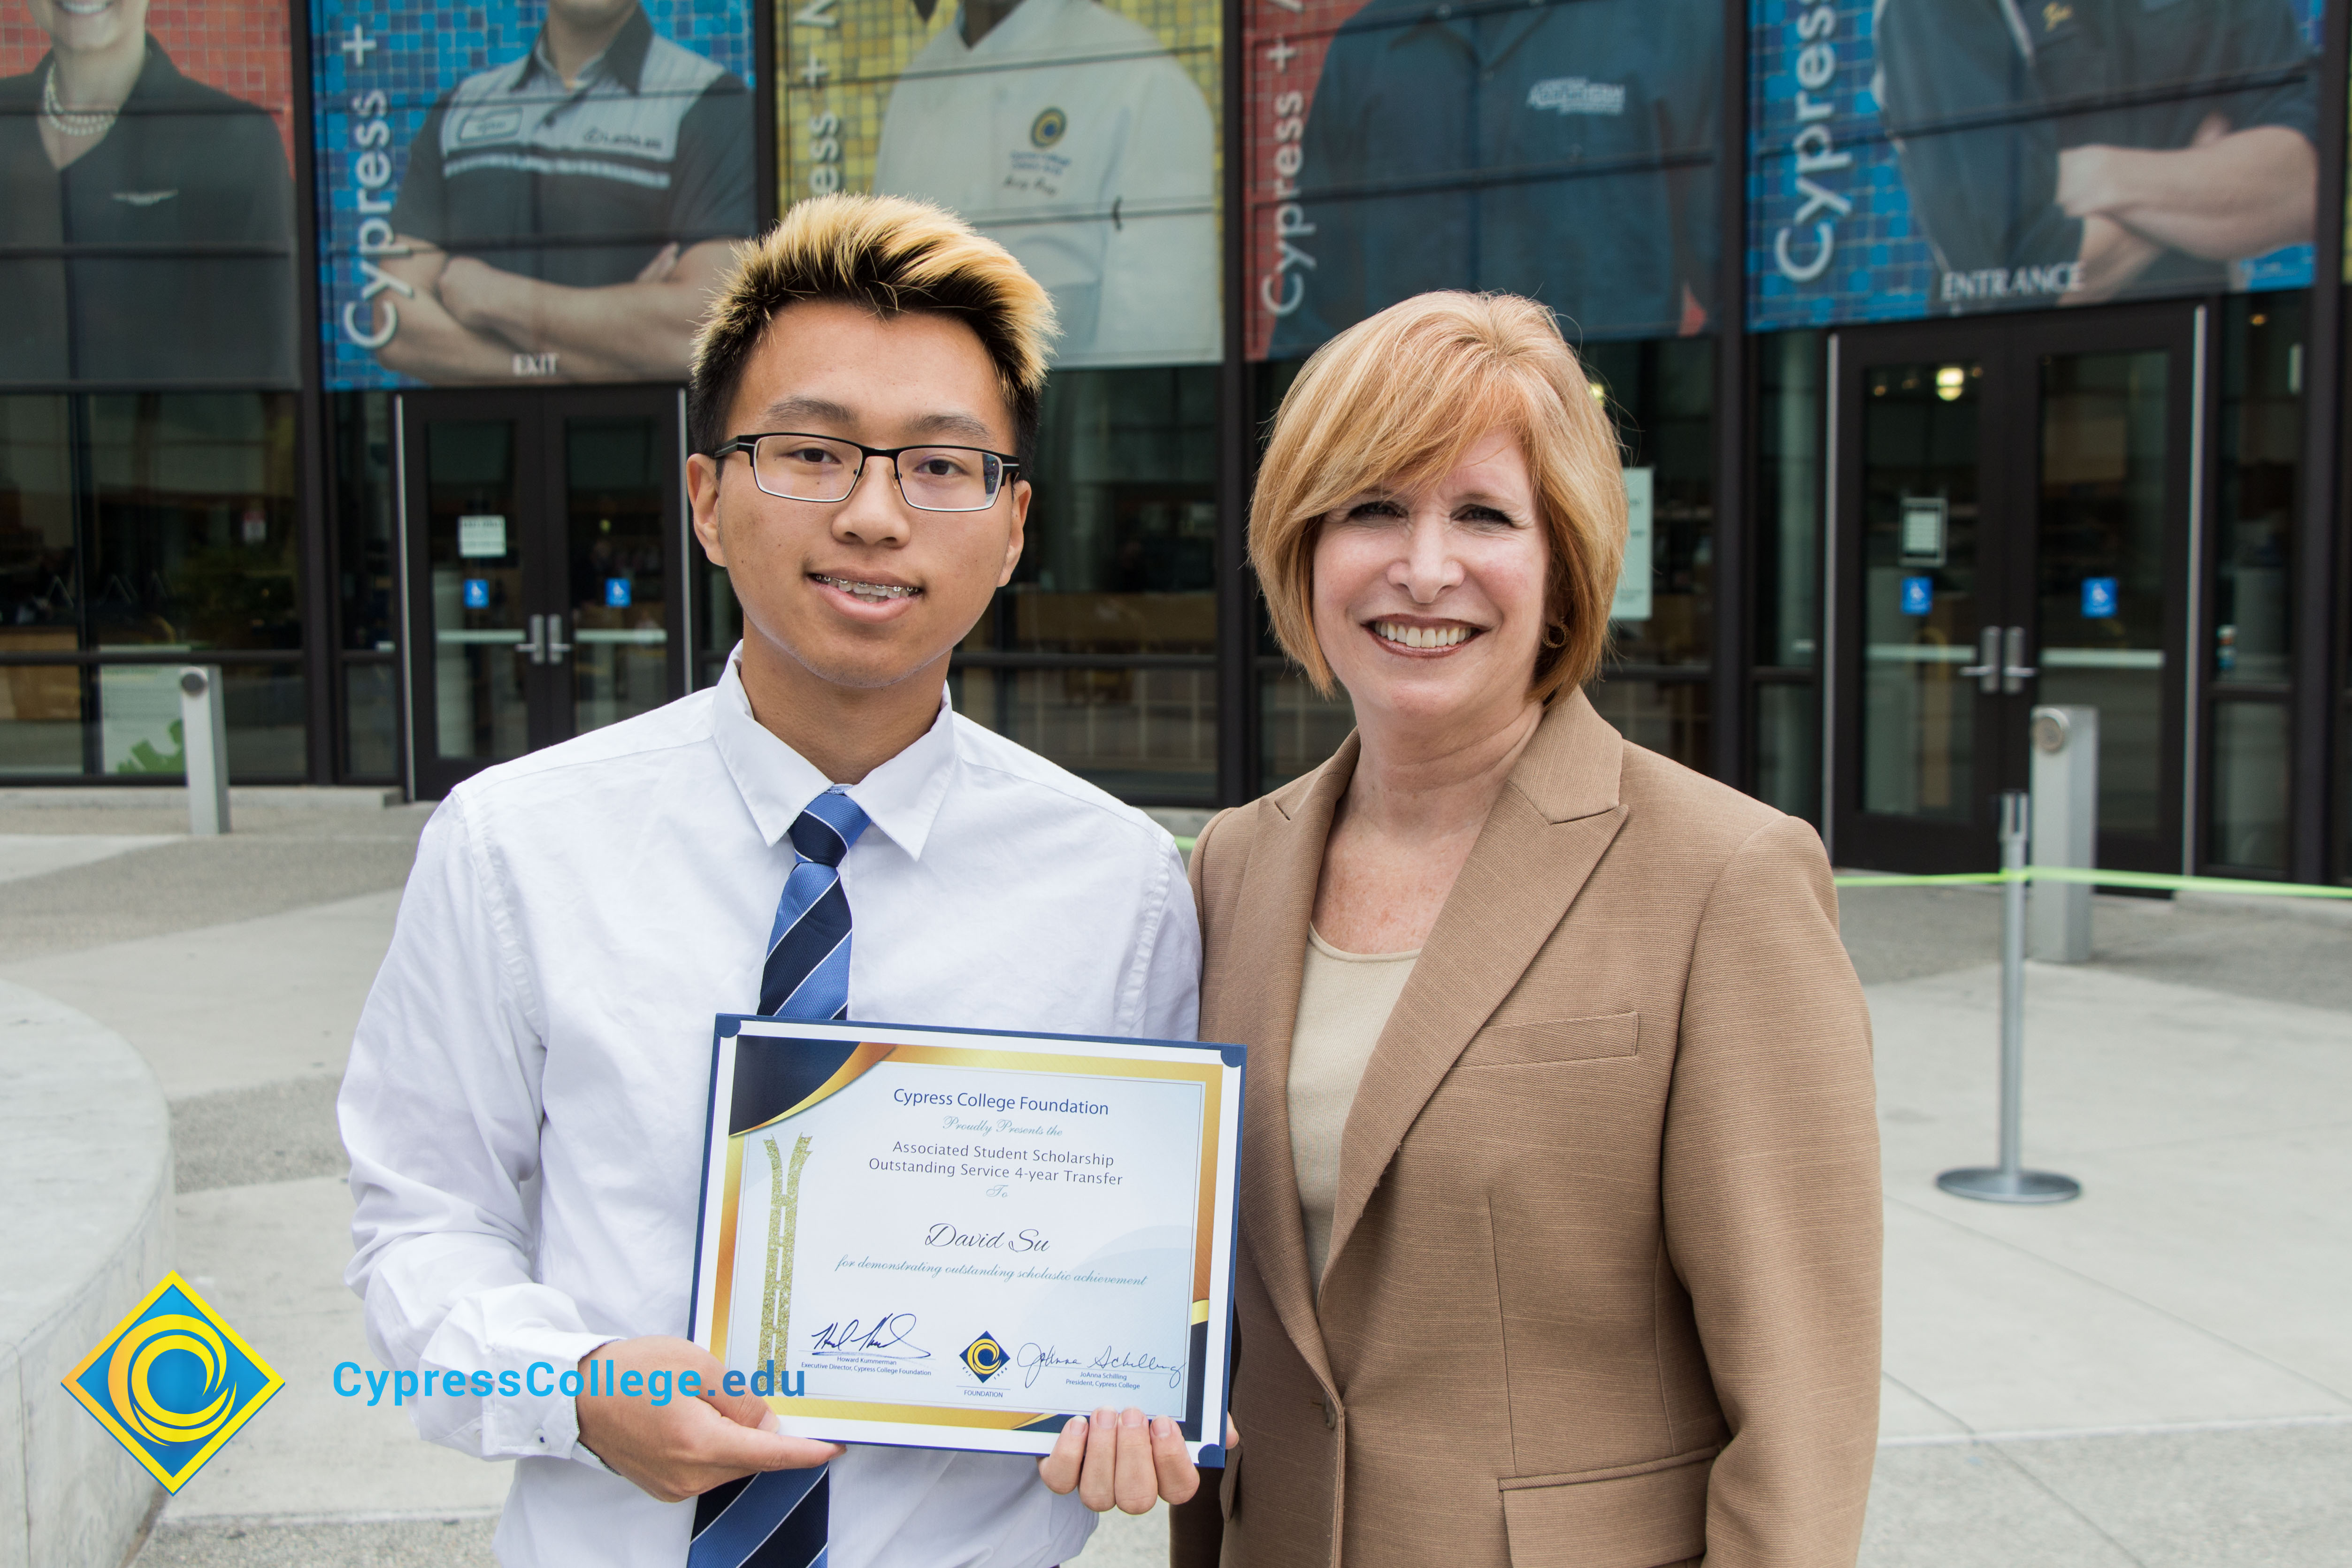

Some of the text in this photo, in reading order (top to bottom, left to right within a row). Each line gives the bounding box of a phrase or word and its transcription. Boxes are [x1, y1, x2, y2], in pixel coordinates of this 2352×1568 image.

[1774, 0, 1852, 281] Cypres
[1261, 91, 1316, 316] Cypress
[343, 89, 414, 349] Cypress
[1941, 262, 2084, 301] ENTRANCE
[512, 353, 559, 376] EXIT
[894, 1088, 1109, 1115] Cypress College Foundation
[942, 1115, 1063, 1137] Proudly Presents the
[892, 1141, 1114, 1168] Associated Student Scholarship
[869, 1158, 1123, 1185] Outstanding Service 4-year Transfer
[986, 1184, 1009, 1198] To
[925, 1223, 1050, 1253] David Su
[835, 1254, 1148, 1285] for demonstrating outstanding scholastic achievement
[964, 1390, 1003, 1398] FOUNDATION
